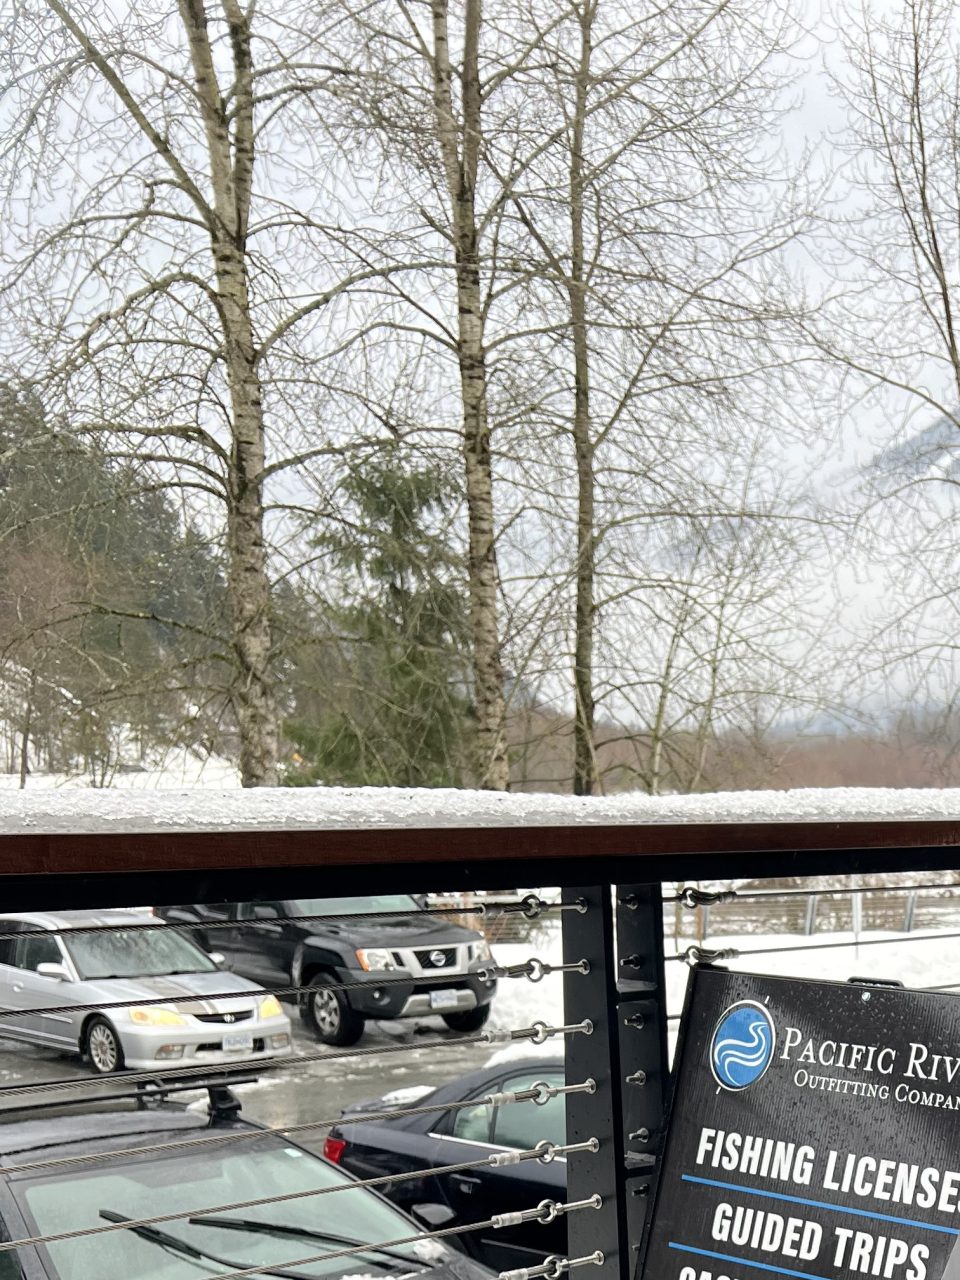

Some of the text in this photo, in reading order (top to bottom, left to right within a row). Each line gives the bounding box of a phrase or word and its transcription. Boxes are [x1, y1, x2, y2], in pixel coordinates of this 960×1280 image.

[780, 1027, 897, 1075] PACIFIC
[794, 1069, 890, 1100] OUTFITTING
[696, 1127, 815, 1186] FISHING
[711, 1203, 823, 1261] GUIDED
